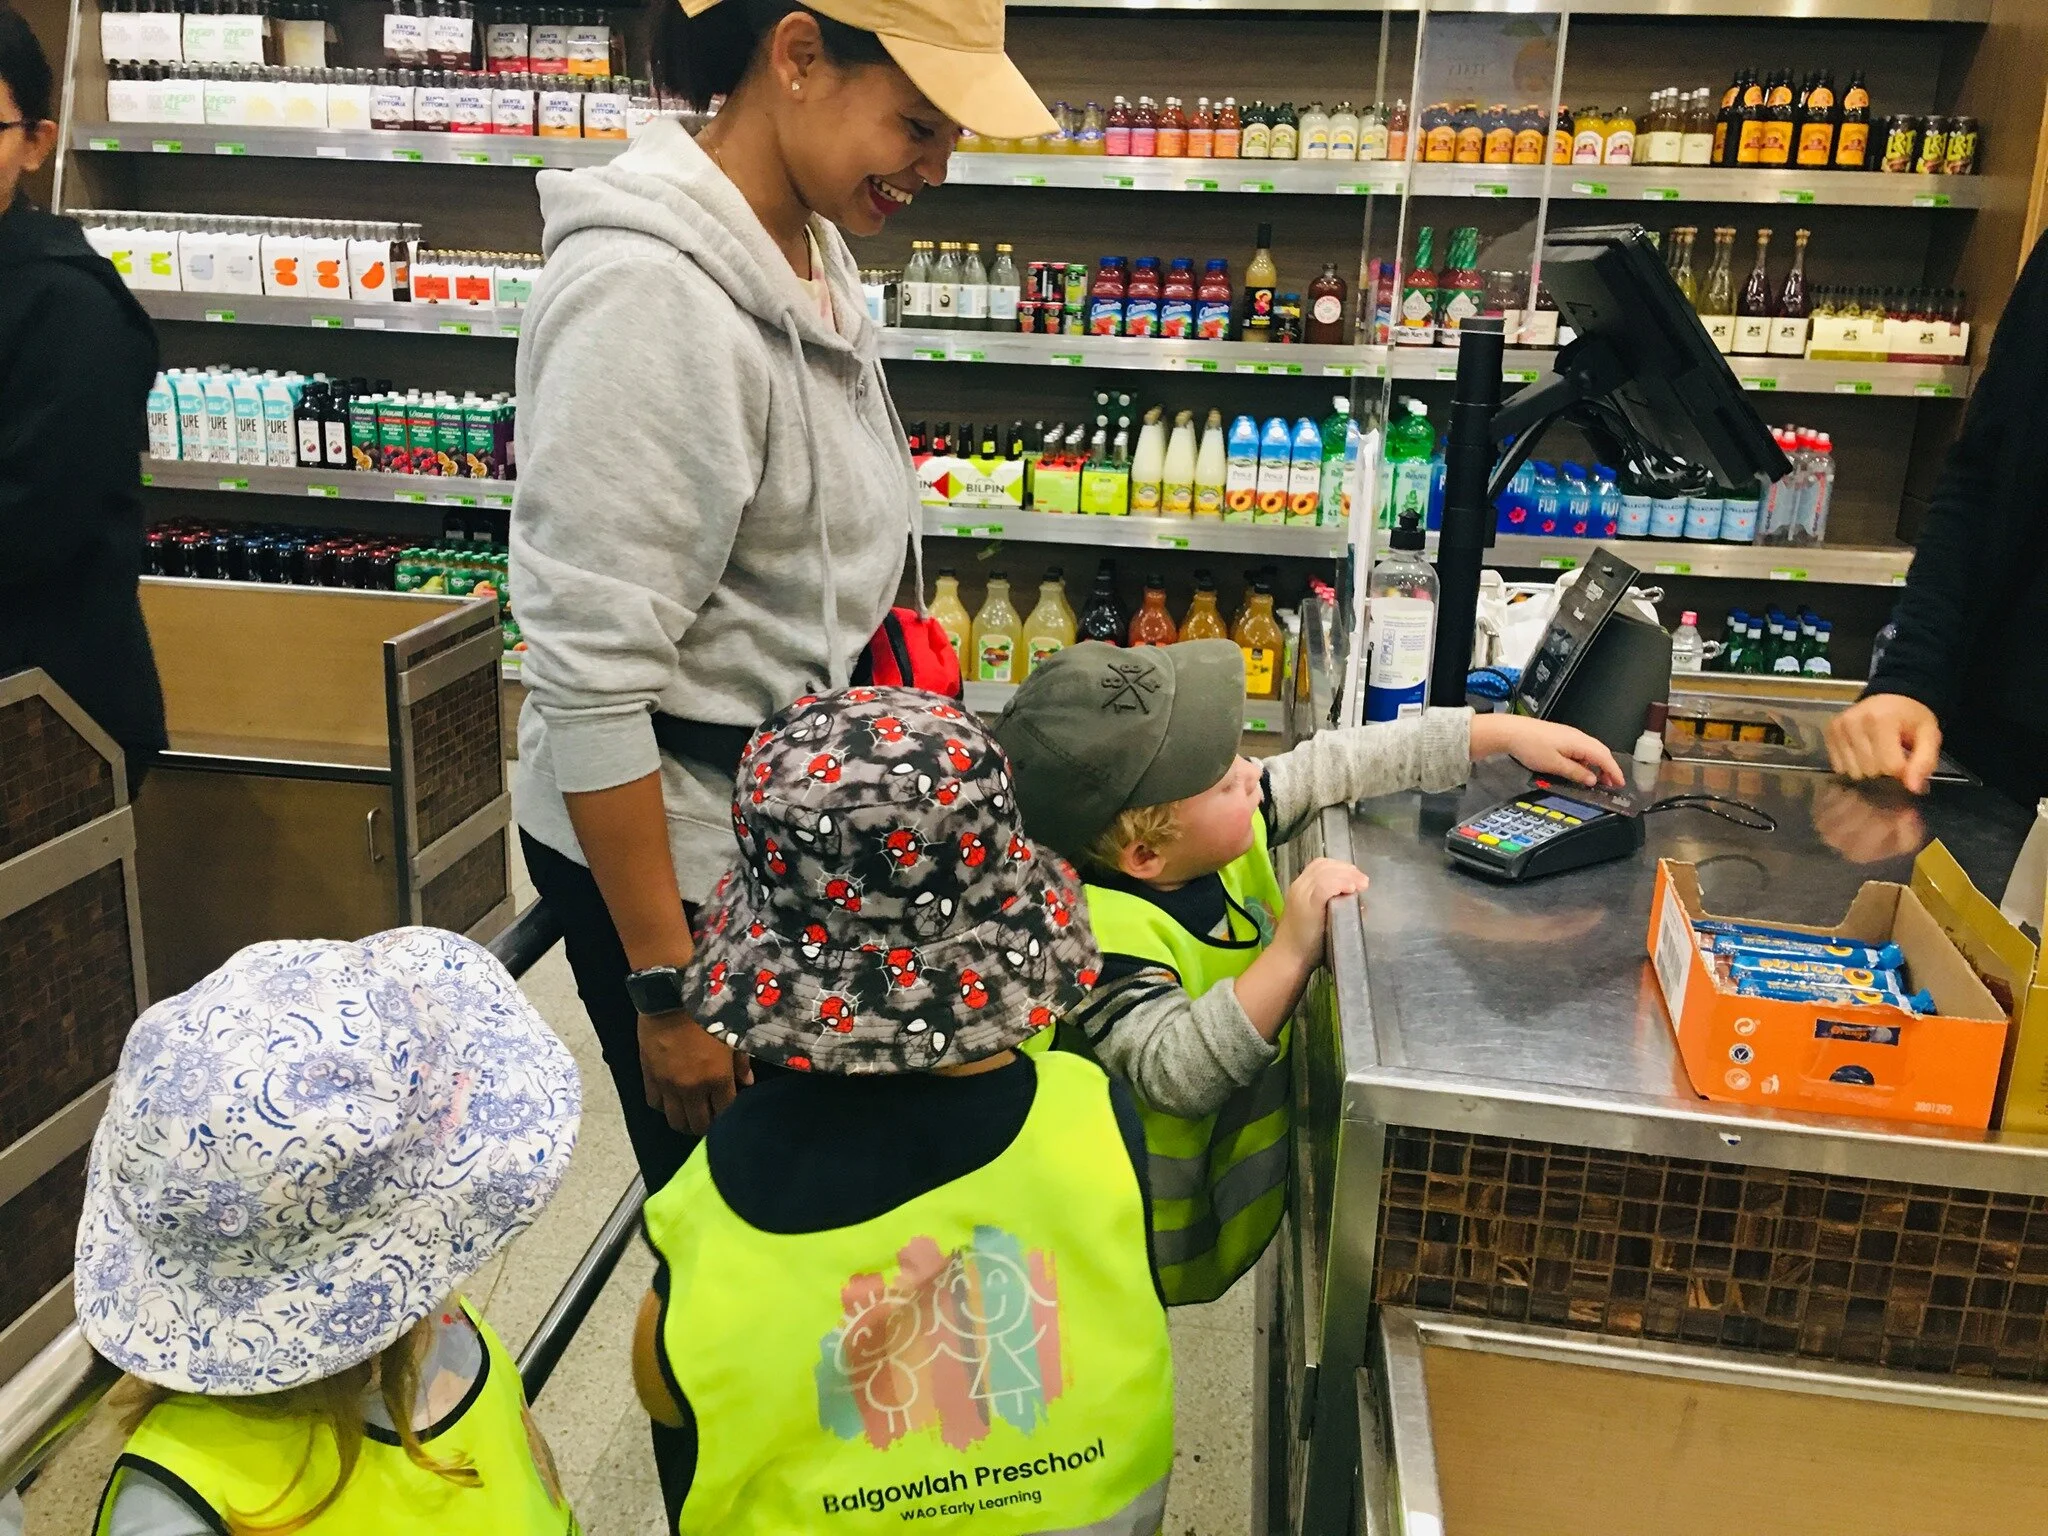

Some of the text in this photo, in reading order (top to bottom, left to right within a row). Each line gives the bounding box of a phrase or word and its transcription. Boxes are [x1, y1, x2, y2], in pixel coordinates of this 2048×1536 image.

[966, 483, 1005, 494] BILPIN
[1507, 477, 1529, 494] FIJI
[1538, 499, 1557, 513] FIJI
[1569, 500, 1590, 516] FIJI
[1600, 501, 1619, 516] FIJI
[822, 1438, 1106, 1513] Balgowlah Preschool
[900, 1489, 1042, 1521] WAO Early Learning
